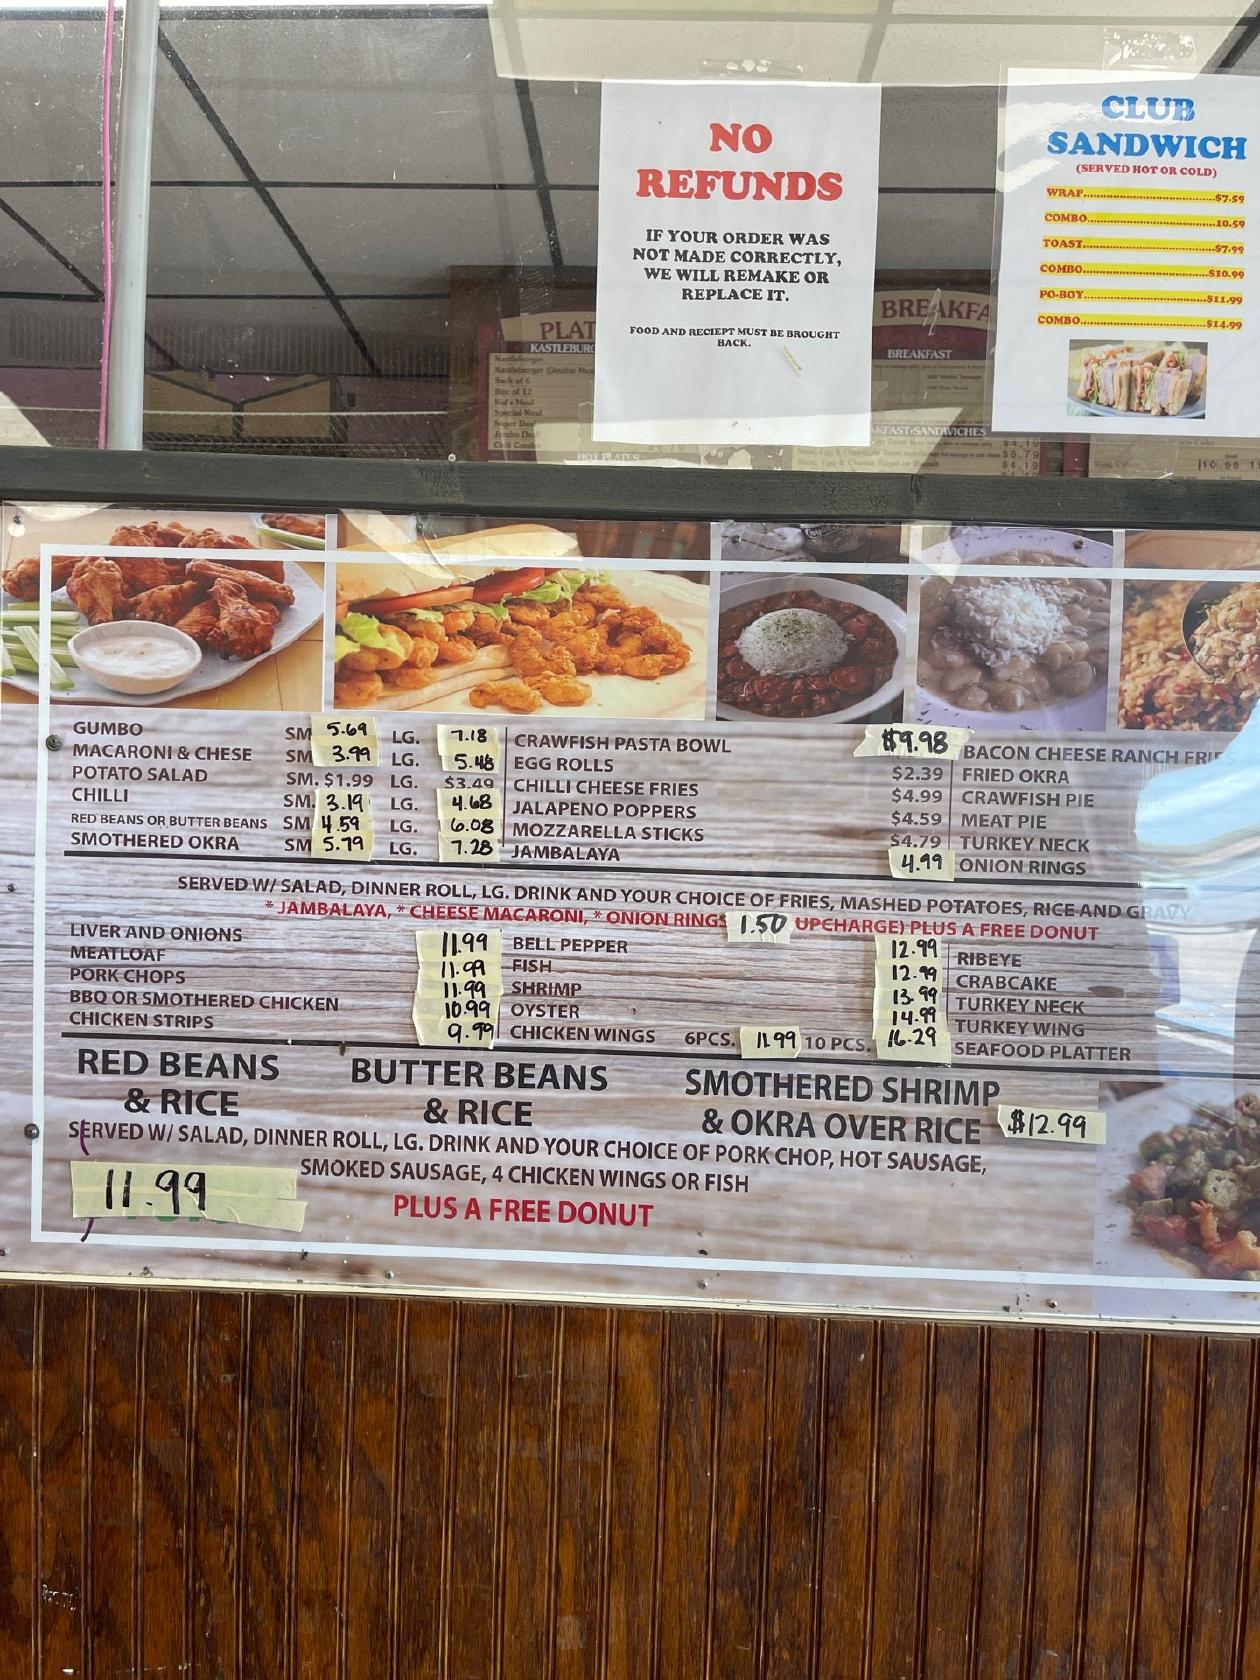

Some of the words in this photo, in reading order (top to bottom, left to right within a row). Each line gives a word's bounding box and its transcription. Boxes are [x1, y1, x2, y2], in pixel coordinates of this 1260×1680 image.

[1102, 95, 1195, 122] CLUB
[710, 123, 772, 153] NO
[1047, 131, 1247, 160] SANDWICH
[1076, 164, 1129, 174] (SERVED
[1133, 165, 1158, 174] HOT
[1160, 166, 1176, 175] OR
[1180, 167, 1217, 178] COLD)
[636, 169, 843, 201] REFUNDS
[646, 229, 663, 241] IF
[668, 230, 718, 244] YOUR
[723, 232, 784, 245] ORDER
[789, 234, 830, 245] WAS
[633, 248, 669, 262] NOT
[674, 250, 725, 263] MADE
[731, 251, 842, 267] CORRECTLY,
[644, 268, 671, 280] WE
[677, 269, 719, 282] WILL
[724, 270, 799, 283] REMAKE
[804, 271, 829, 284] OR
[682, 288, 762, 300] REPLACE
[767, 290, 789, 302] IT.
[630, 326, 659, 335] FOOD
[662, 327, 686, 336] AND
[688, 328, 735, 336] RECIEPT
[737, 328, 767, 336] MUST
[770, 329, 784, 337] BE
[786, 329, 840, 339] BROUGHT
[717, 339, 751, 347] BACK.
[887, 349, 952, 359] BREAKFAST
[73, 721, 143, 736] GUMBO
[326, 721, 368, 737] 5.69
[451, 728, 487, 742] 7.18
[515, 734, 609, 749] CRAWFISH
[614, 737, 671, 751] PASTA
[677, 739, 732, 753] BOWL
[881, 729, 949, 754] $9.98
[73, 744, 172, 760] MACARONI
[178, 746, 189, 760] &
[195, 747, 252, 761] CHESE
[333, 745, 371, 763] 3.99
[964, 745, 1032, 761] BACON
[1035, 746, 1106, 763] CHEESE
[1111, 748, 1179, 764] RANCH
[515, 757, 551, 770] EGG
[557, 758, 614, 772] ROLLS
[72, 766, 142, 780] POTATO
[148, 767, 208, 782] SALAD
[324, 773, 374, 787] $1.99
[445, 776, 494, 788] $3.49
[892, 766, 944, 781] $2.39
[962, 768, 1014, 784] FRIED
[1019, 769, 1069, 784] OKRA
[72, 788, 128, 802] CHILLI
[514, 779, 570, 793] CHILLI
[576, 780, 644, 795] CHEESE
[650, 783, 698, 796] FRIES
[892, 788, 943, 804] $4.99
[326, 793, 363, 812] 3.19
[452, 794, 492, 811] 4.68
[961, 789, 1060, 807] CRAWFISH
[1066, 793, 1094, 808] PIE
[513, 801, 608, 816] JALAPENO
[613, 804, 696, 819] POPPERS
[71, 814, 97, 824] RED
[100, 814, 143, 825] BEANS
[148, 815, 166, 825] OR
[169, 816, 220, 827] BUTTER
[224, 818, 267, 829] BEANS
[322, 815, 360, 833] 4.59
[450, 818, 494, 833] 6.08
[892, 811, 942, 827] $4.59
[961, 813, 1013, 829] MEAT
[1018, 815, 1047, 830] PIE
[513, 823, 636, 839] MOZZARELLA
[642, 826, 704, 841] STICKS
[71, 832, 183, 848] SMOTHERED
[189, 835, 239, 851] OKRA
[323, 836, 363, 851] 5.79
[451, 839, 493, 855] 7.28
[890, 834, 941, 849] $4.79
[960, 836, 1035, 851] TURKEY
[1040, 837, 1090, 853] NECK
[511, 845, 620, 861] JAMBALAYA
[901, 853, 943, 873] 4.99
[960, 858, 1023, 874] ONION
[1029, 860, 1086, 876] RINGS
[513, 936, 557, 950] BELL
[561, 939, 628, 954] PEPPER
[891, 938, 938, 959] 12.99
[512, 959, 552, 973] FISH
[957, 952, 1021, 968] RIBEYE
[892, 965, 937, 981] 12.99
[512, 982, 582, 997] SHRIMP
[956, 975, 1057, 991] CRABCAKE
[893, 986, 938, 1005] 13.99
[511, 1003, 579, 1019] OYSTER
[956, 997, 1029, 1012] TURKEY
[1035, 999, 1085, 1014] NECK
[893, 1007, 936, 1025] 14.99
[510, 1025, 589, 1041] CHICKEN
[594, 1027, 656, 1043] WINGS
[955, 1019, 1028, 1034] TURKEY
[1034, 1022, 1085, 1037] WING
[888, 1028, 937, 1048] 16.29
[954, 1042, 1044, 1058] SEAFOOD
[1050, 1045, 1131, 1061] PLATTER
[78, 1048, 148, 1076] RED
[160, 1052, 280, 1080] BEANS
[352, 1058, 484, 1088] BUTTER
[494, 1062, 608, 1092] BEANS
[685, 1069, 873, 1102] SMOTHERED
[882, 1076, 1001, 1107] SHRIMP
[124, 1088, 150, 1114] &
[160, 1088, 239, 1116] RICE
[423, 1098, 447, 1124] &
[459, 1099, 533, 1127] RICE
[702, 1108, 722, 1135] &
[731, 1109, 815, 1139] OKRA
[824, 1112, 907, 1142] OVER
[915, 1117, 981, 1145] RICE
[1007, 1108, 1087, 1138] $12.99
[106, 1169, 206, 1214] 11.99
[394, 1194, 457, 1219] PLUS
[464, 1197, 481, 1220] A
[489, 1198, 550, 1223] FREE
[558, 1200, 654, 1227] DONUT
